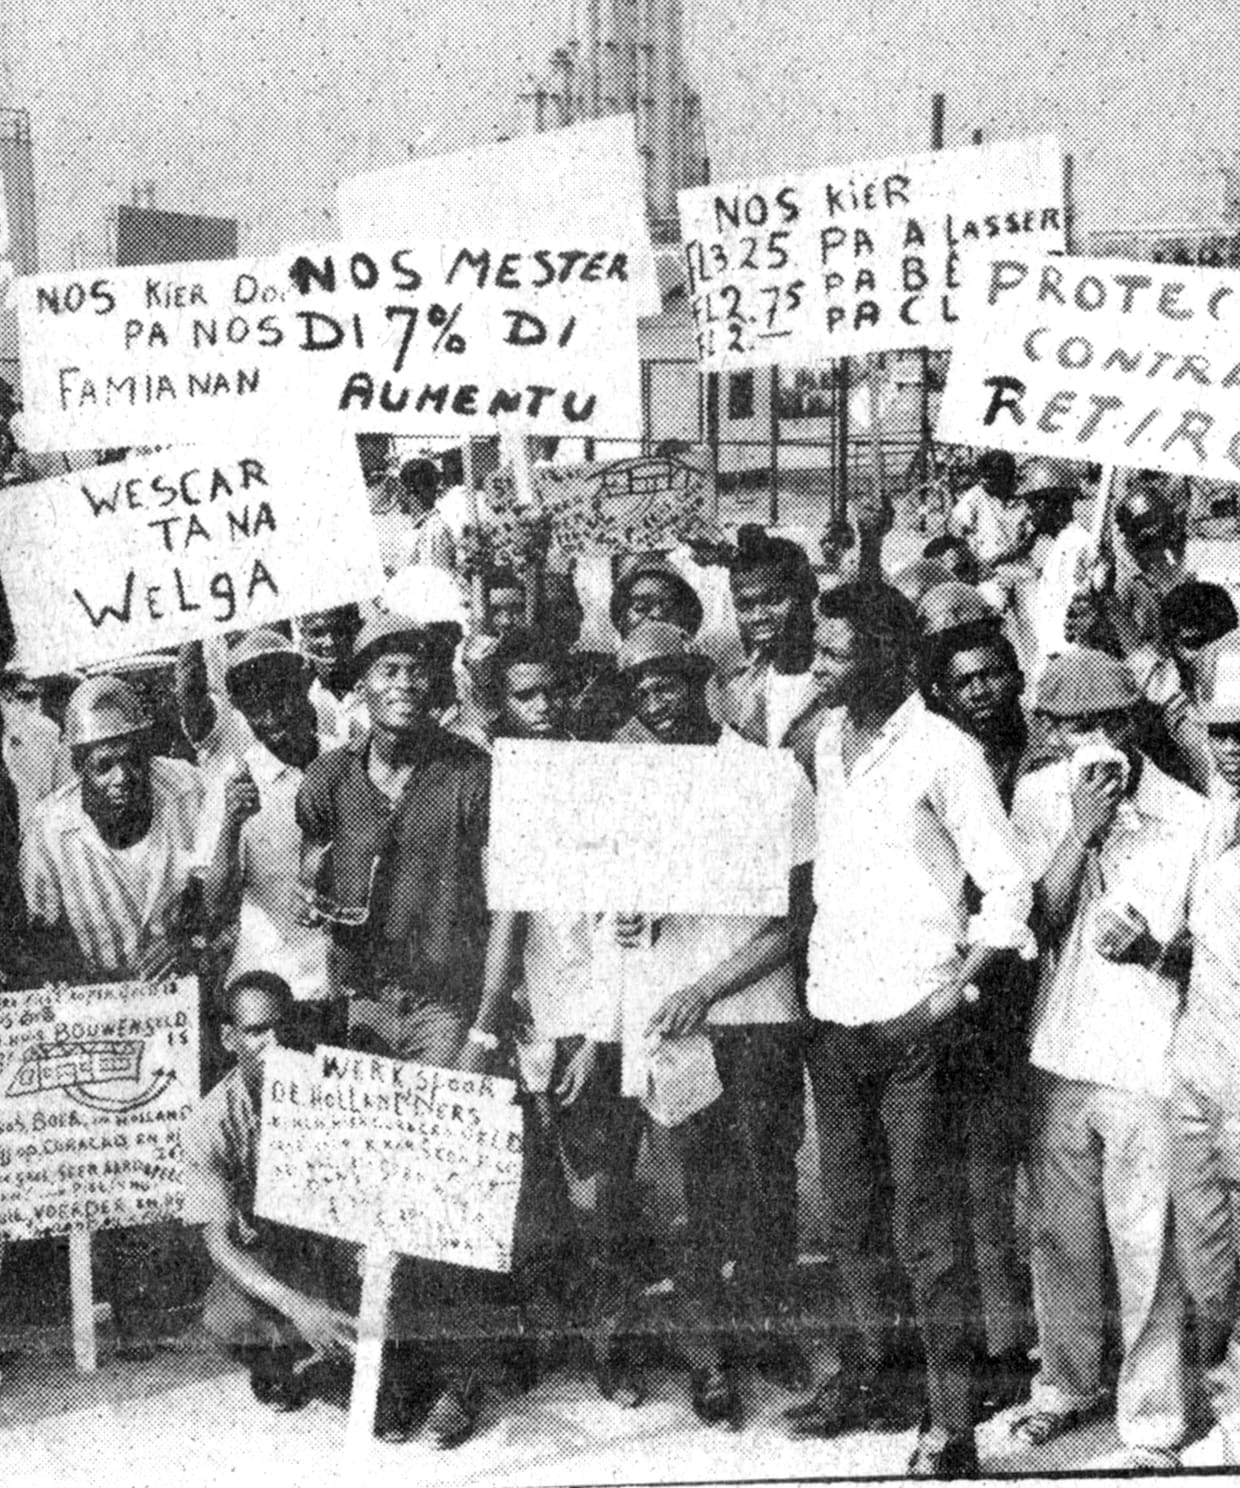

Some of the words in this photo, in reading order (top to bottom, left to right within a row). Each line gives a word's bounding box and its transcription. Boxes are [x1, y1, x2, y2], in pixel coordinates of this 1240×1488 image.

[715, 187, 801, 233] NOS
[821, 227, 873, 263] PA
[904, 218, 926, 248] A
[945, 208, 1061, 246] LASSER
[290, 248, 422, 294] NOS
[446, 247, 629, 290] MESTER
[825, 269, 875, 296] PA
[36, 279, 116, 315] NOS
[826, 302, 879, 332] PA
[124, 320, 169, 349] PA
[192, 314, 286, 348] NOS
[297, 311, 364, 351] DI
[385, 303, 466, 372] 7%
[503, 309, 576, 348] DI
[338, 370, 598, 423] AUMENTU
[81, 459, 270, 517] WESCAR
[149, 515, 210, 551] TA
[227, 502, 278, 541] NA
